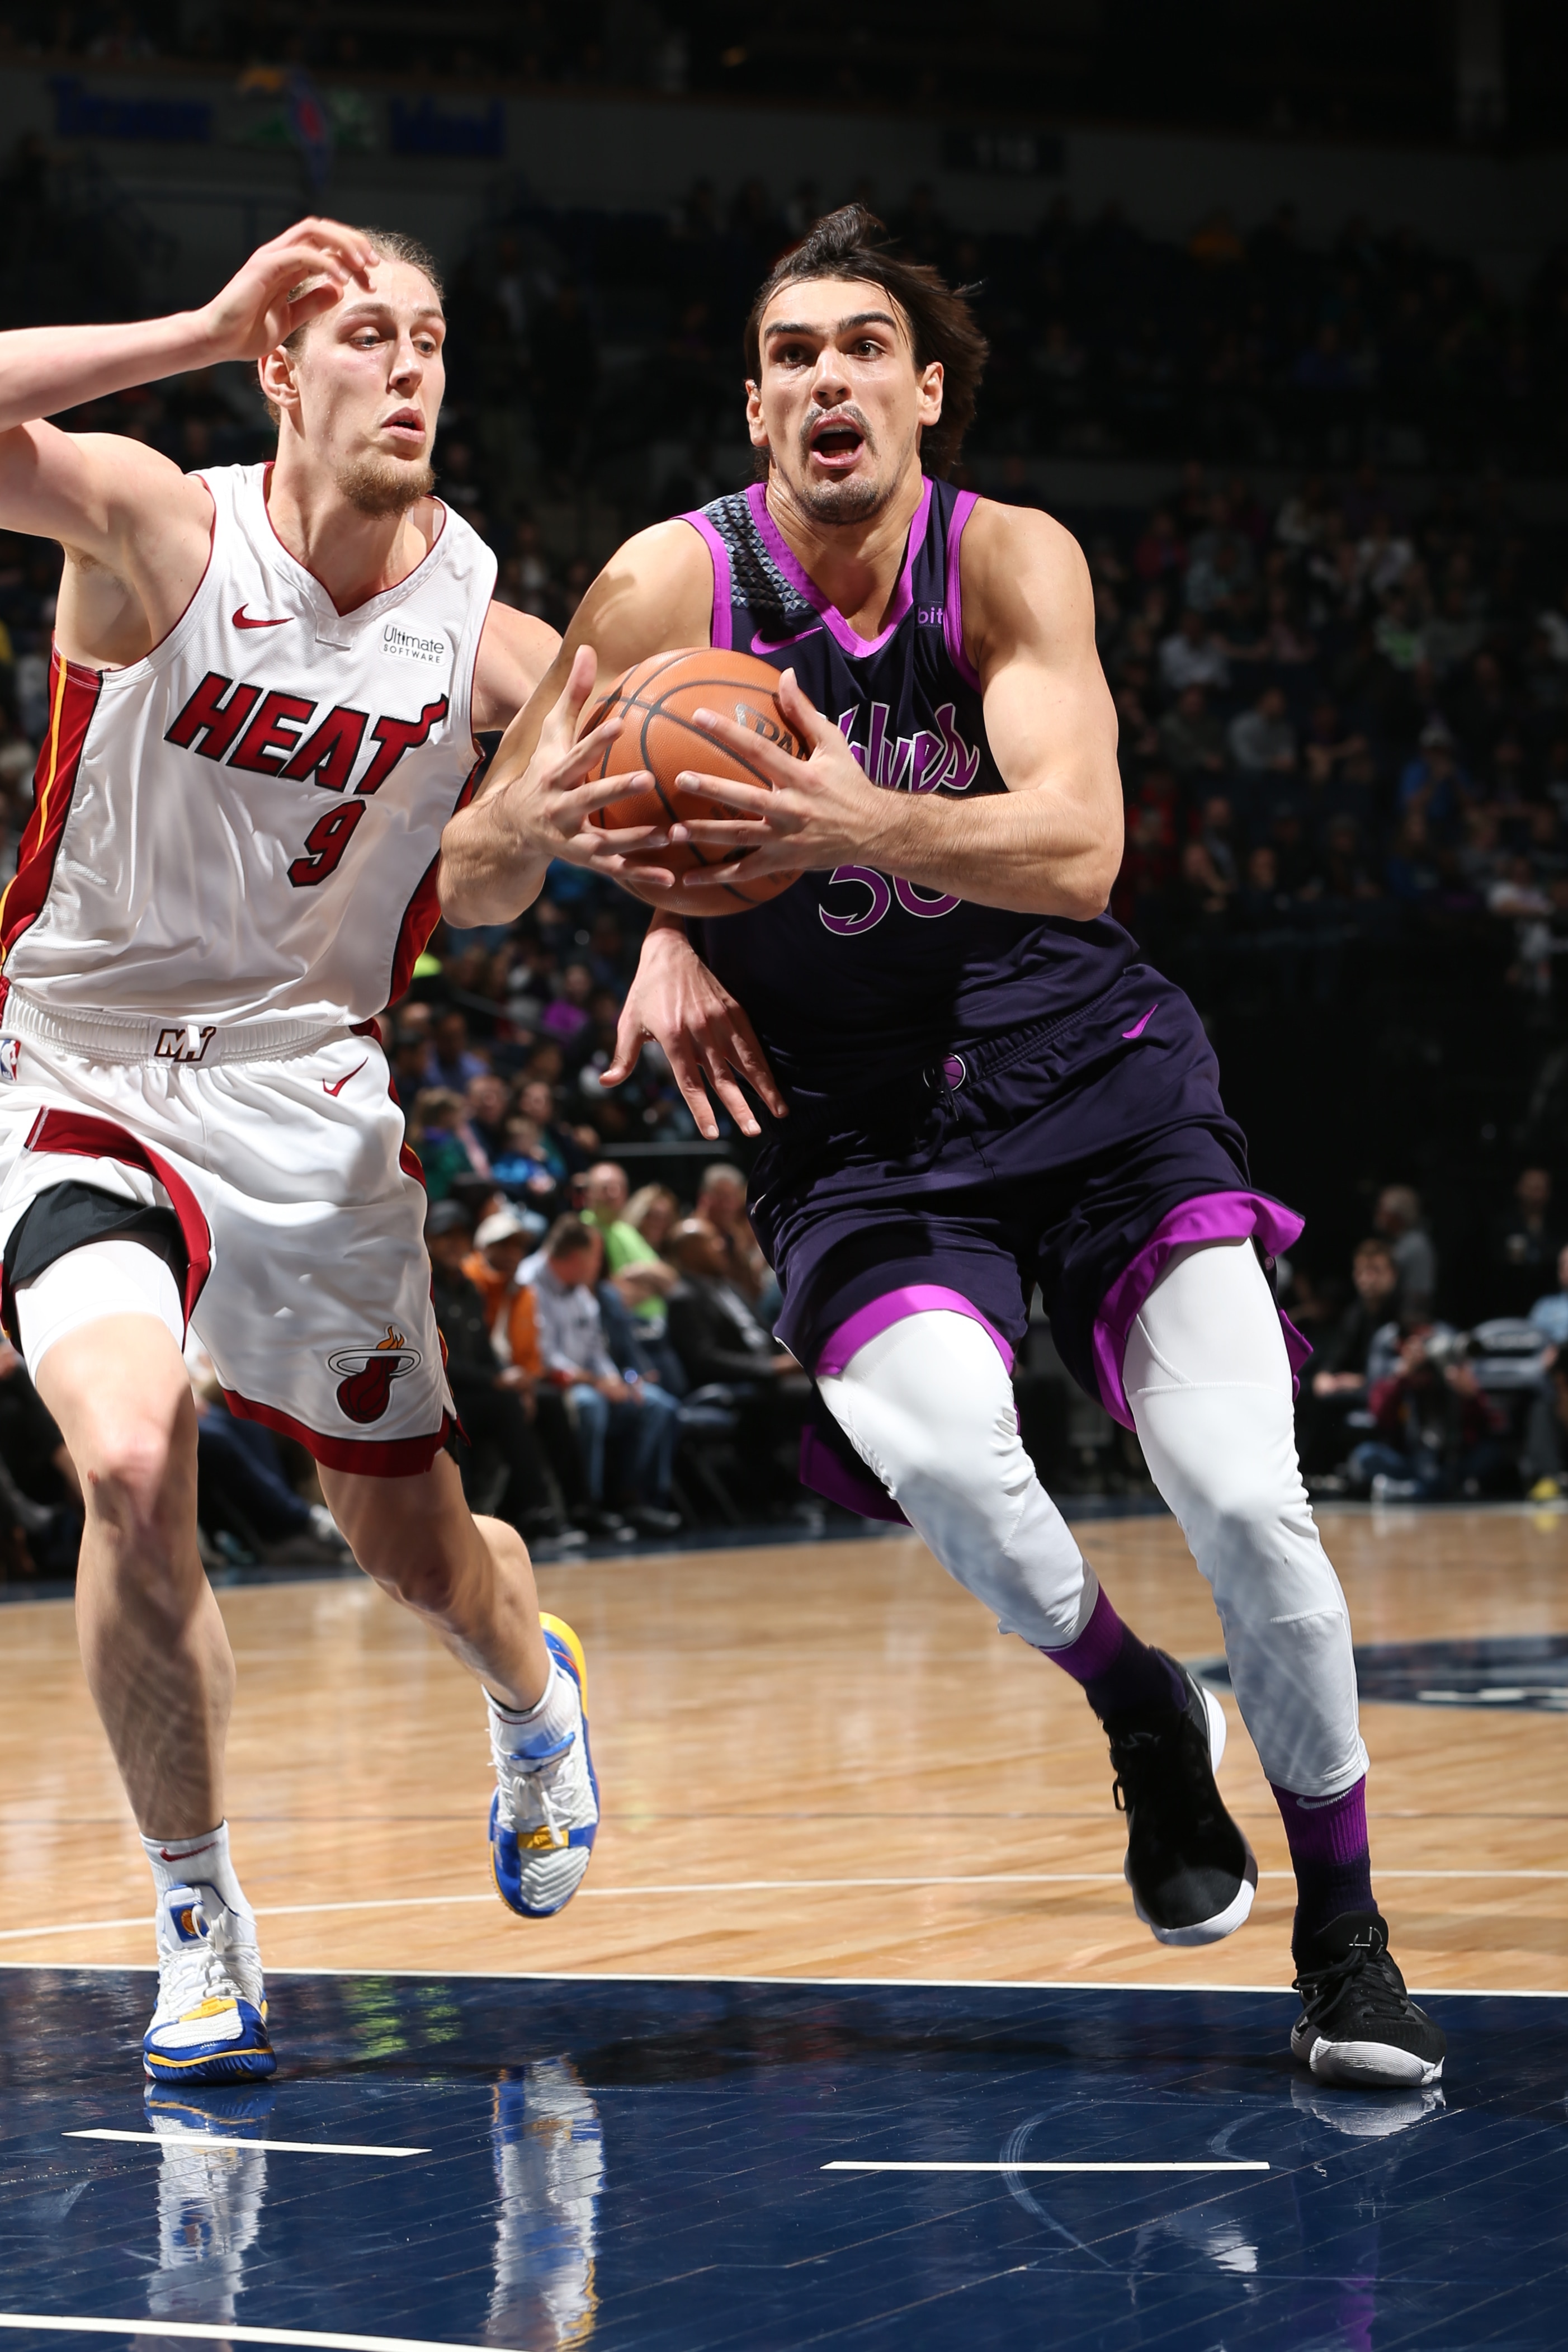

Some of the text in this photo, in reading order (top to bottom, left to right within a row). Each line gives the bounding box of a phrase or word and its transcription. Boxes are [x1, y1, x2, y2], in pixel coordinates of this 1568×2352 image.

[384, 623, 444, 653] Ultimate
[384, 644, 441, 663] SOFTWARE
[164, 671, 448, 795] HEAT
[838, 701, 980, 794] lves
[287, 799, 367, 888] 9
